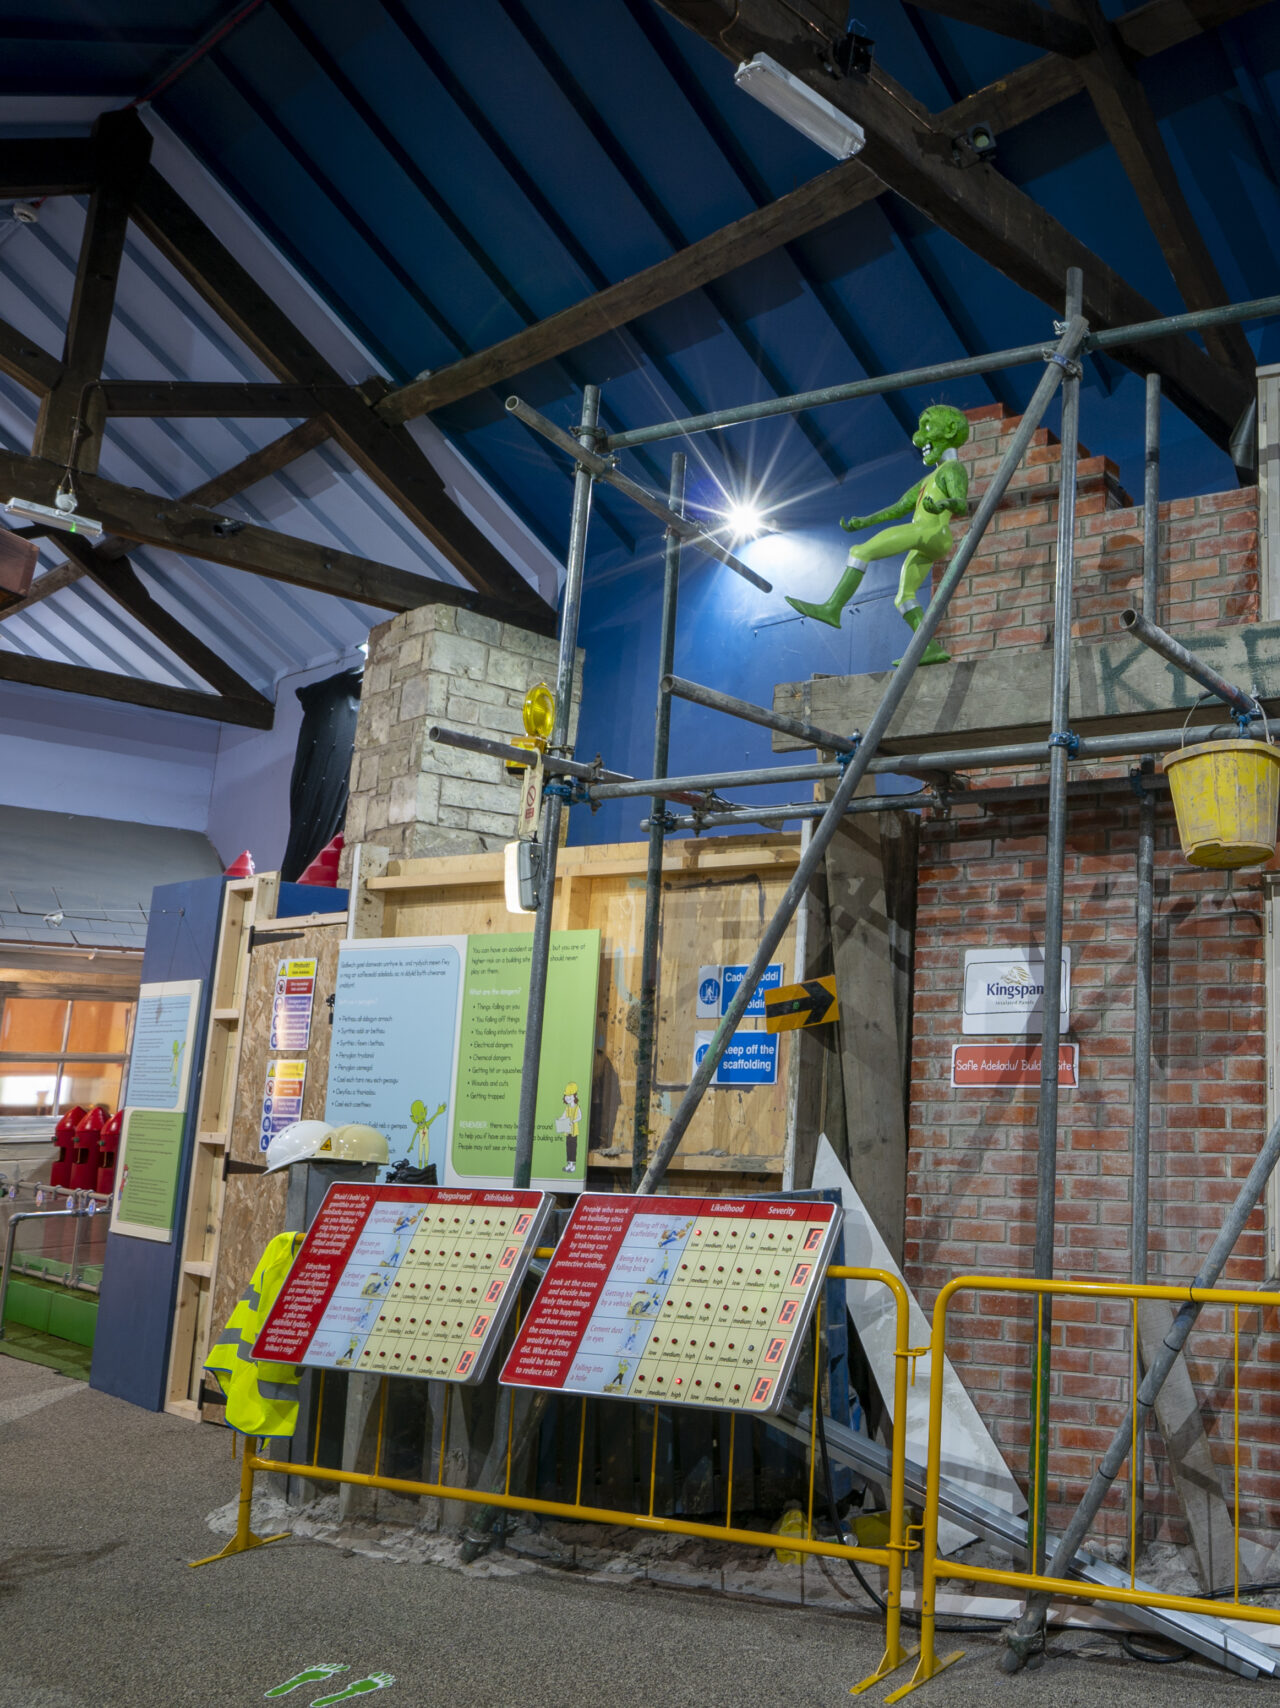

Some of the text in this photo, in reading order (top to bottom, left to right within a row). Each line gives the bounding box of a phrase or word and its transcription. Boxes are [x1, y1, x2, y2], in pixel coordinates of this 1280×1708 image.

[987, 983, 1044, 999] Kingspan
[725, 1044, 774, 1056] eep off the
[723, 1060, 771, 1072] scaffolding
[956, 1060, 978, 1071] Safle
[1021, 1060, 1042, 1070] Build
[711, 1204, 796, 1215] Likelihood Severity
[569, 1241, 577, 1249] by
[577, 1242, 596, 1250] taking
[556, 1260, 583, 1268] protective
[541, 1296, 556, 1304] likely
[572, 1299, 591, 1308] things
[559, 1308, 581, 1317] happen
[539, 1328, 578, 1337] consequences
[558, 1339, 572, 1347] they
[532, 1346, 548, 1354] What
[548, 1348, 569, 1356] actions
[545, 1358, 561, 1366] taken
[523, 1367, 542, 1375] reduce
[543, 1368, 557, 1376] risk?
